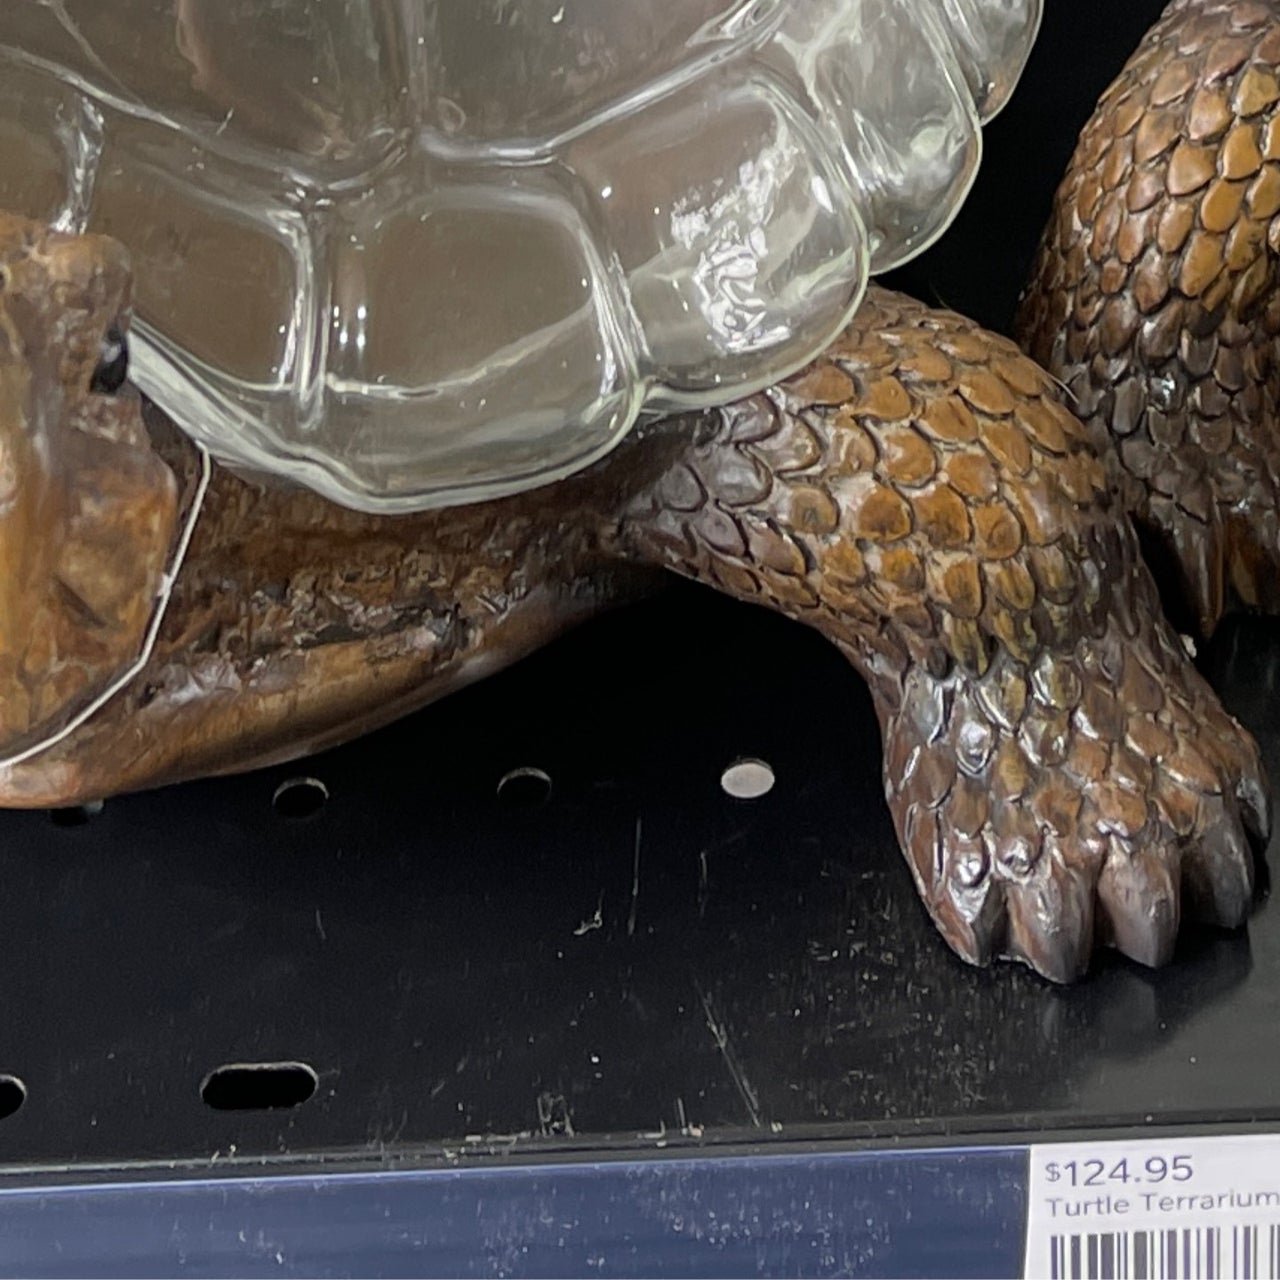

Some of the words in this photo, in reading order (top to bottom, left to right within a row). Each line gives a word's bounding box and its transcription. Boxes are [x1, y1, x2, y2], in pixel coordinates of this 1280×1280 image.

[1044, 1154, 1194, 1187] $124.95
[1045, 1194, 1130, 1218] Turtle
[1138, 1187, 1280, 1212] Terrarium
